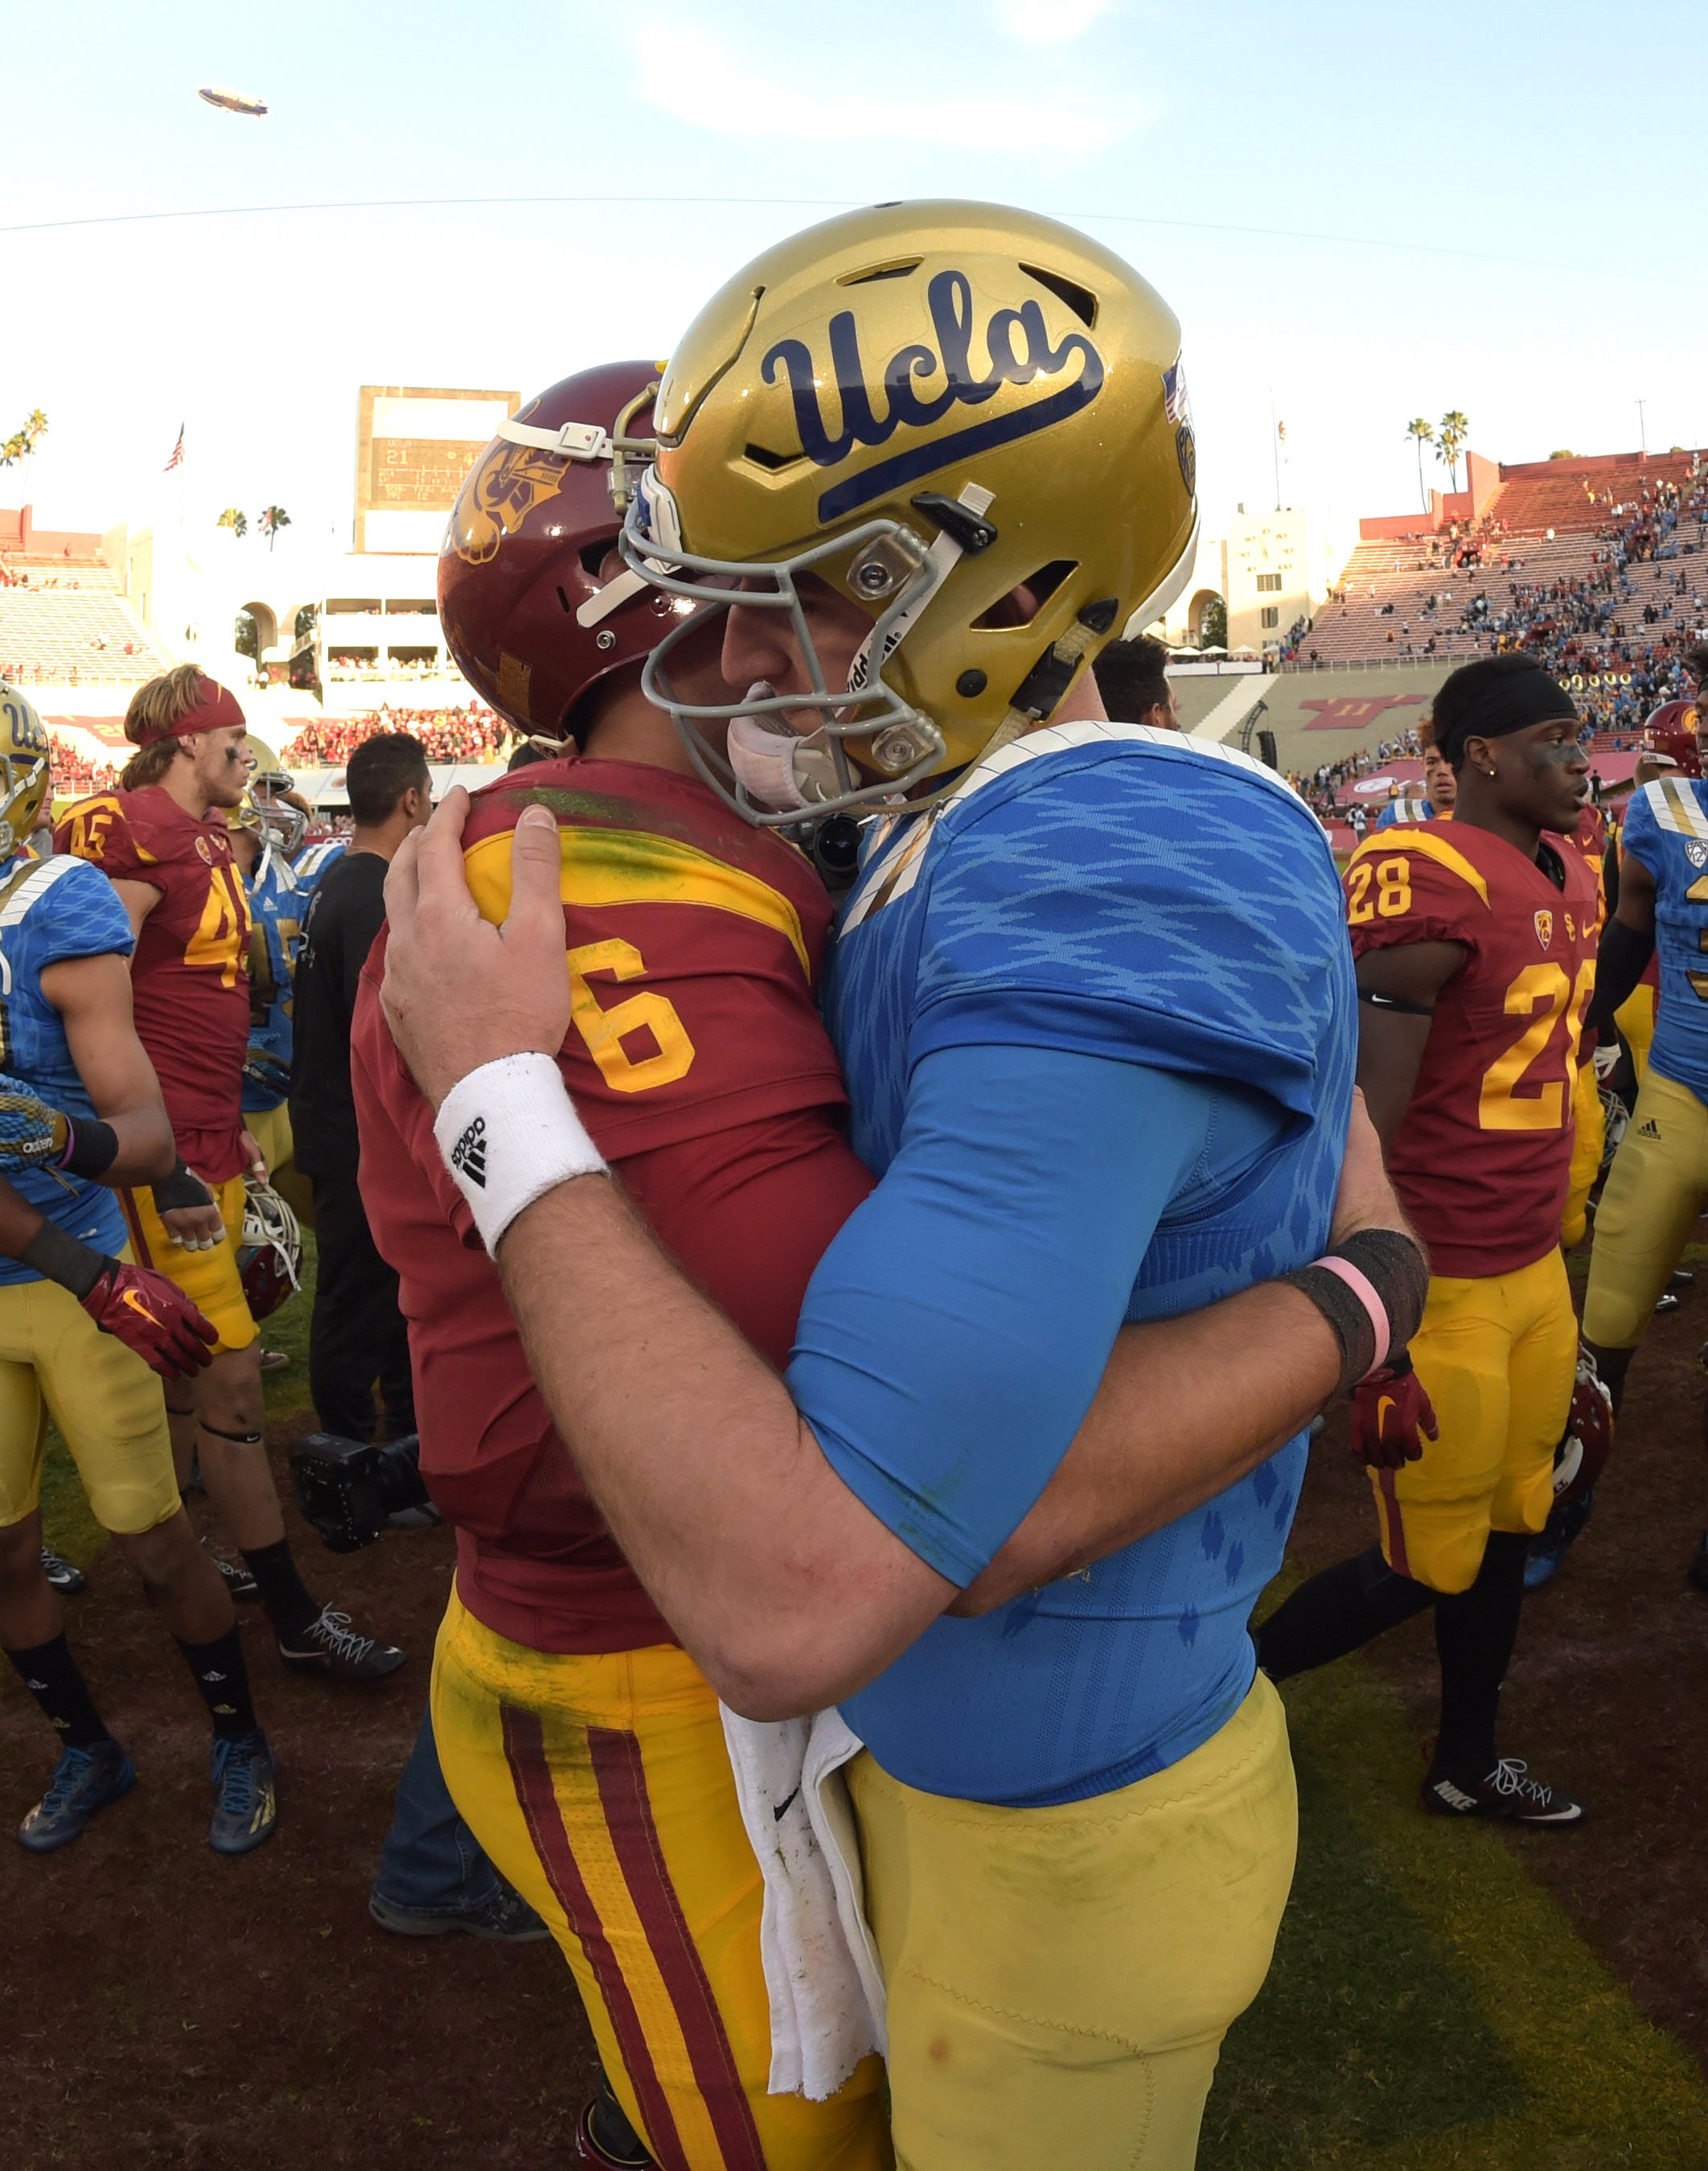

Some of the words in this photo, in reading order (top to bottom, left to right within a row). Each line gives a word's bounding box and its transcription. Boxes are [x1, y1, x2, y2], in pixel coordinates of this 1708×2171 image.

[762, 270, 1105, 476] Ucla
[386, 449, 409, 465] 21
[1334, 703, 1372, 717] 11
[71, 814, 113, 860] 45
[1692, 851, 1705, 863] 12
[1348, 857, 1411, 924] 28
[566, 937, 696, 1094] 6
[450, 1116, 487, 1168] adidas
[1433, 1779, 1478, 1811] NIKE
